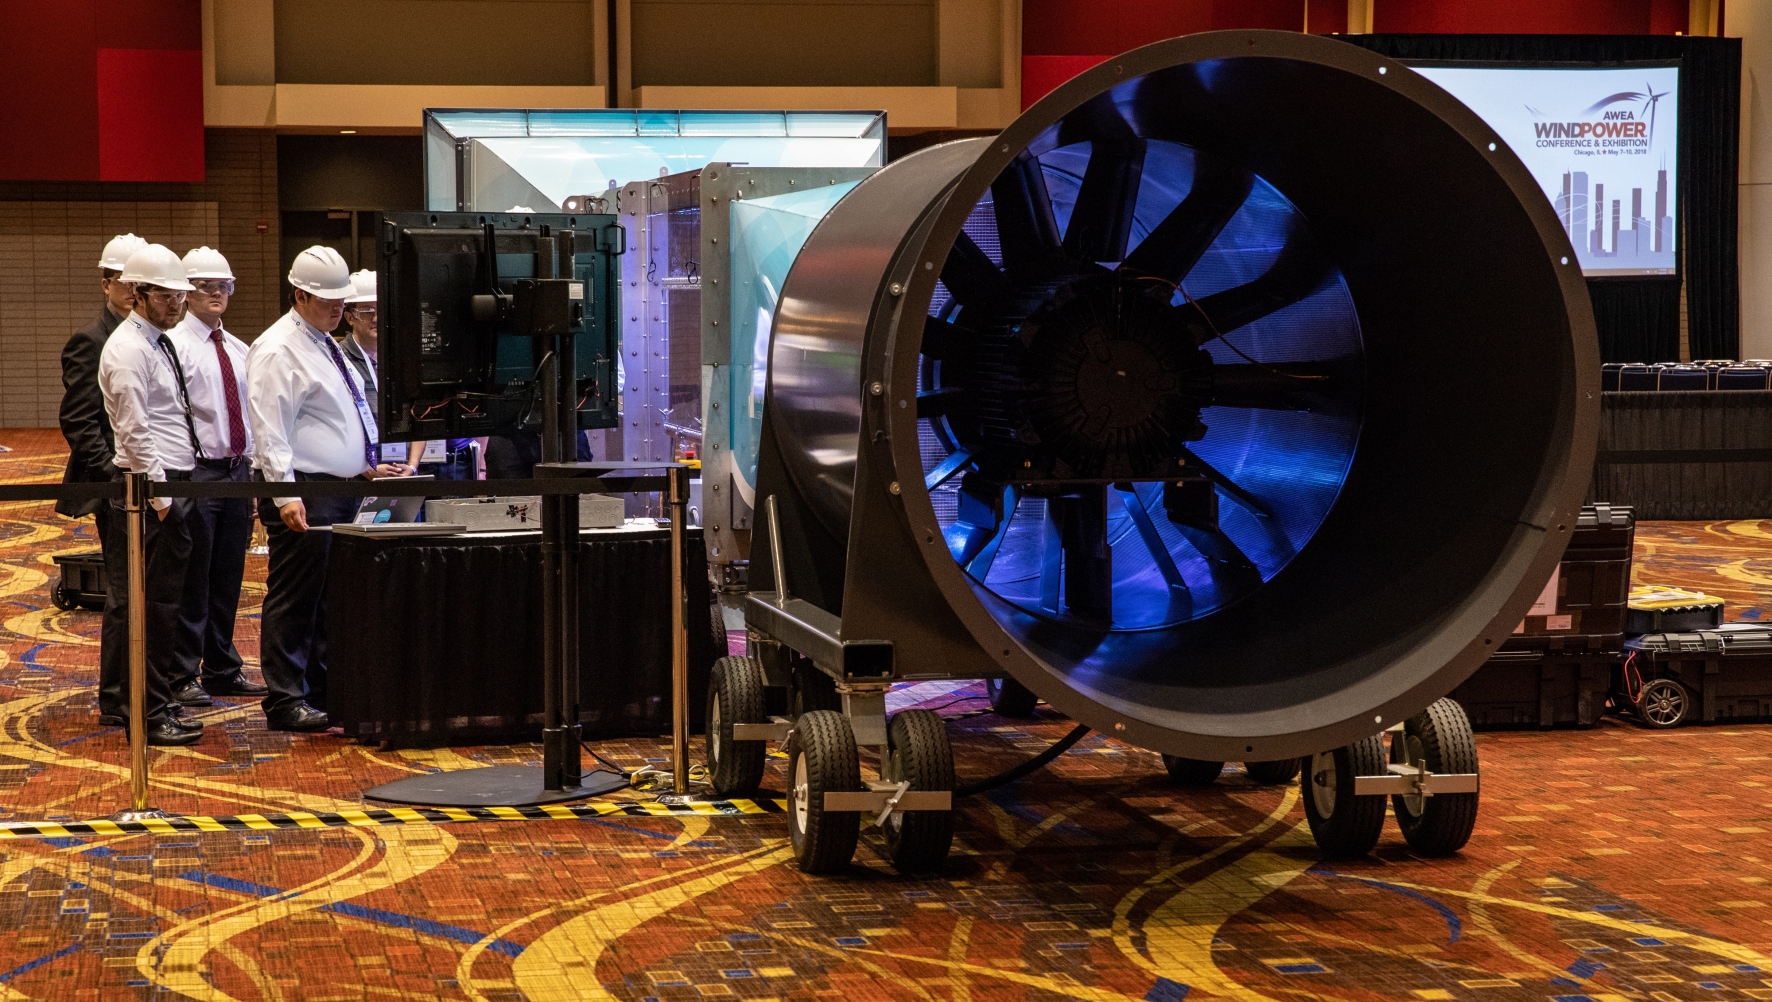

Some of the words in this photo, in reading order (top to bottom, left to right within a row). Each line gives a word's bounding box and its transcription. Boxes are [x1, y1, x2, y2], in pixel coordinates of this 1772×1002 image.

[1603, 111, 1634, 120] AWEA
[1534, 122, 1646, 138] WINDPOWER
[1536, 140, 1592, 148] CONFERENCE
[1602, 139, 1647, 147] EXHIBITION
